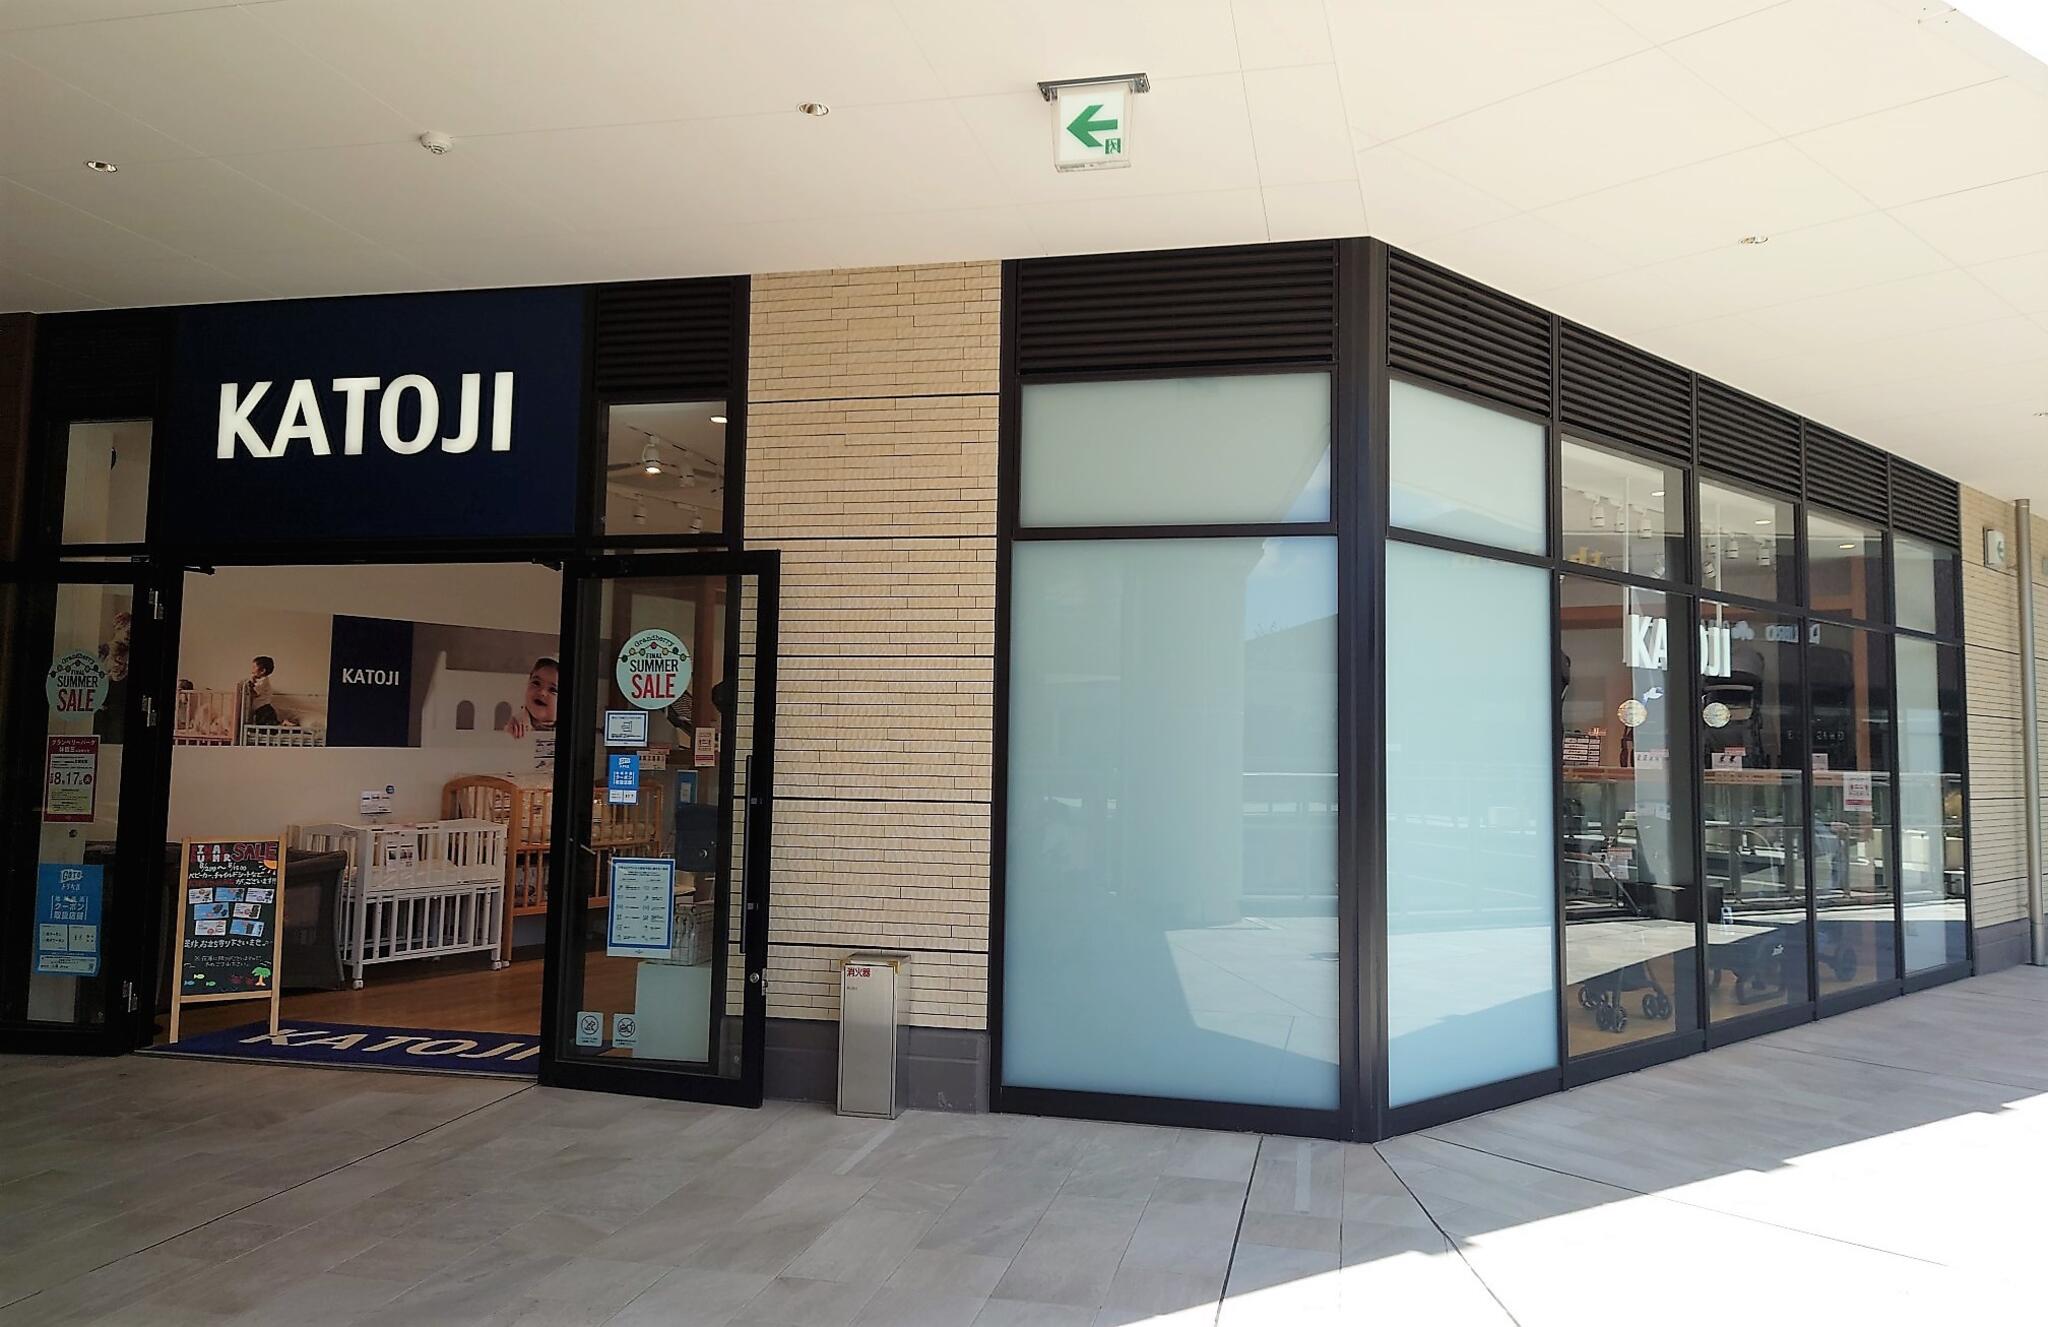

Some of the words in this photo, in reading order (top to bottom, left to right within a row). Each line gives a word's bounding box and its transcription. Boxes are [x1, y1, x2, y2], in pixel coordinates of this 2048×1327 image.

[217, 371, 514, 460] KATOJI
[634, 634, 675, 647] Grandberry
[629, 659, 679, 673] SUMMER
[56, 675, 98, 688] SUMMER
[341, 667, 400, 687] KATOJI
[631, 673, 676, 699] SALE
[56, 688, 96, 712] SALE
[231, 842, 277, 862] SALE
[53, 903, 85, 912] クーポン
[846, 967, 871, 978] 消火器
[238, 1028, 541, 1061] KATOJI
